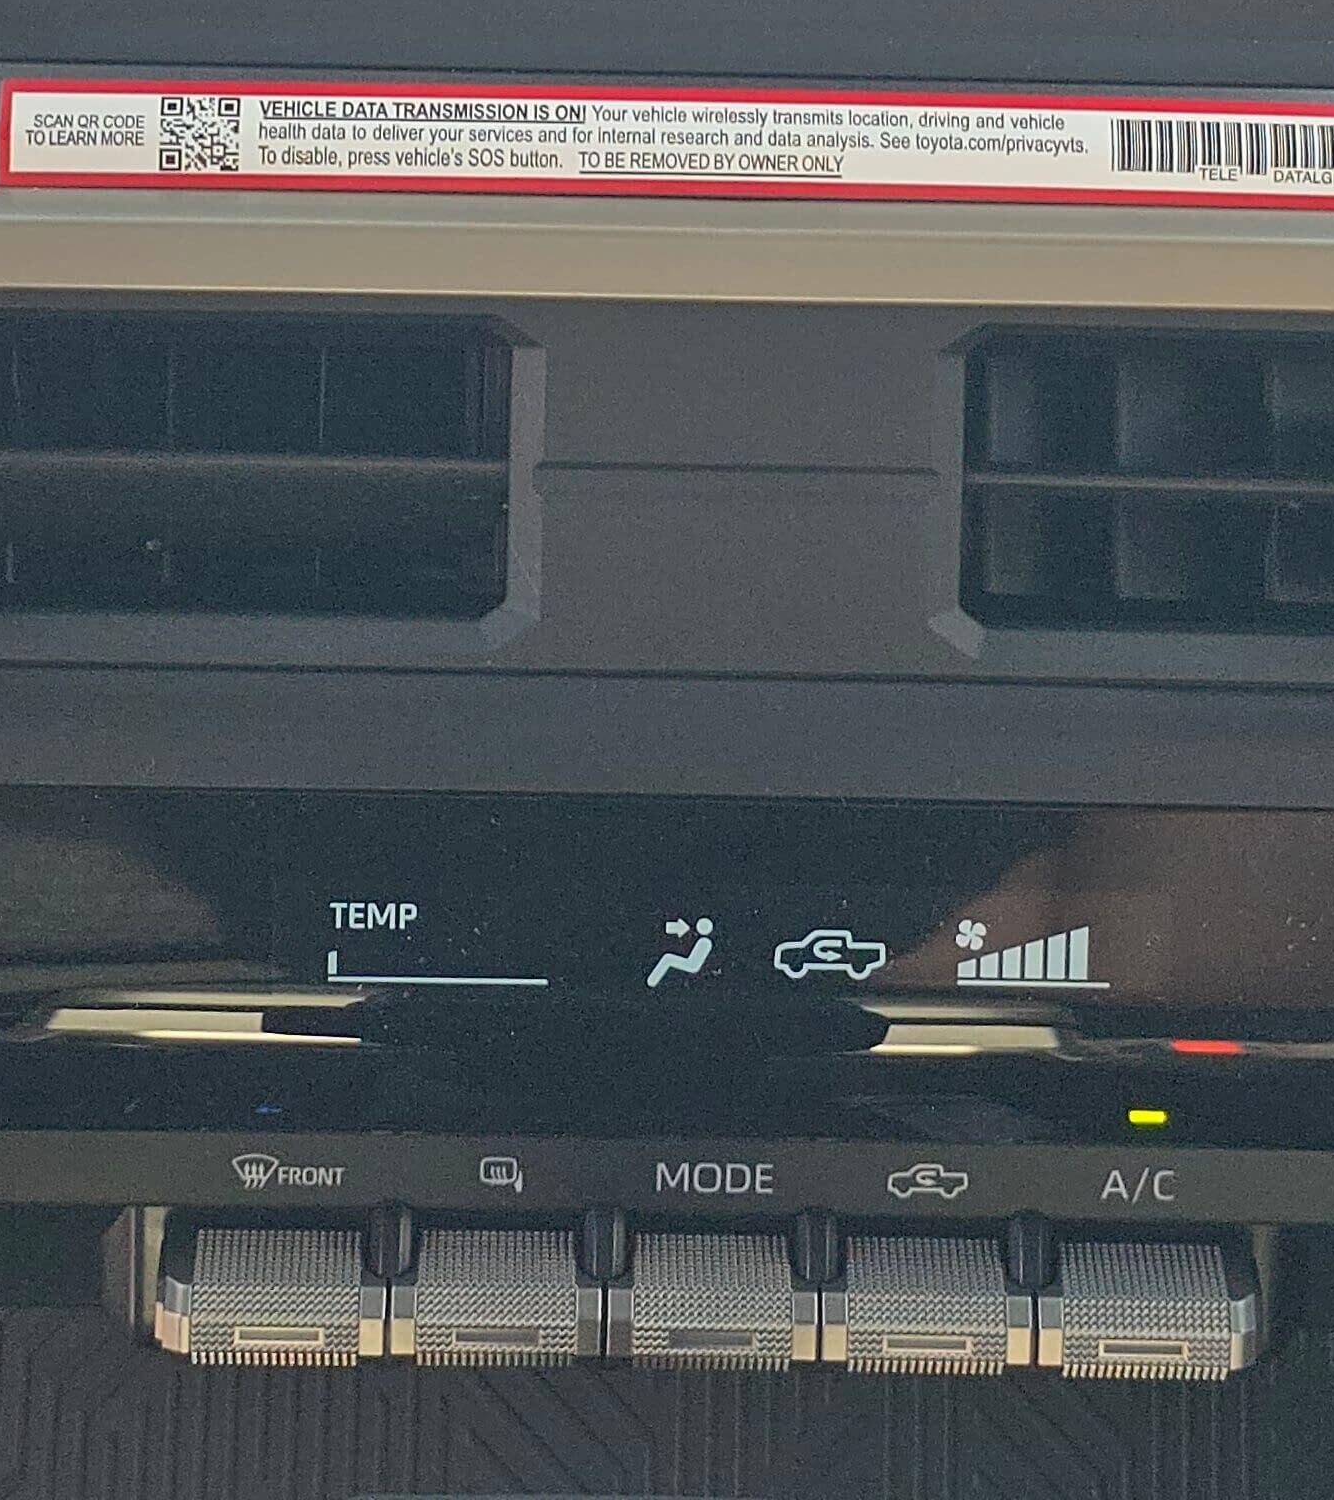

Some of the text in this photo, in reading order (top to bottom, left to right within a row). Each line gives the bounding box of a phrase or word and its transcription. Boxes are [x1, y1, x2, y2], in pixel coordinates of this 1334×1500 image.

[33, 114, 146, 128] SCAN QR CODE
[259, 101, 1065, 132] VEHICLE DATA TRANSMISSION IS ON! Your vehicle wirelessly transmits location, driving and vehicle
[26, 130, 145, 146] TO LEARN MORE
[258, 122, 307, 141] health
[311, 123, 346, 140] data
[352, 124, 366, 140] to
[373, 124, 425, 141] deliver
[430, 128, 464, 145] your
[469, 126, 533, 143] services
[538, 126, 567, 143] and
[573, 126, 593, 143] for
[598, 128, 655, 144] internal
[661, 129, 728, 146] research
[734, 130, 762, 146] and
[768, 131, 801, 147] data
[807, 132, 874, 152] analysis.
[880, 132, 910, 149] See
[258, 145, 844, 173] To disable, press vehicle's SOS button. TO BE REMOVED BY OWNER ONLY
[1198, 167, 1237, 182] TELE
[330, 902, 418, 930] TEMP
[277, 1166, 346, 1188] FRONT
[654, 1163, 775, 1195] MODE
[1099, 1168, 1177, 1203] A/C
